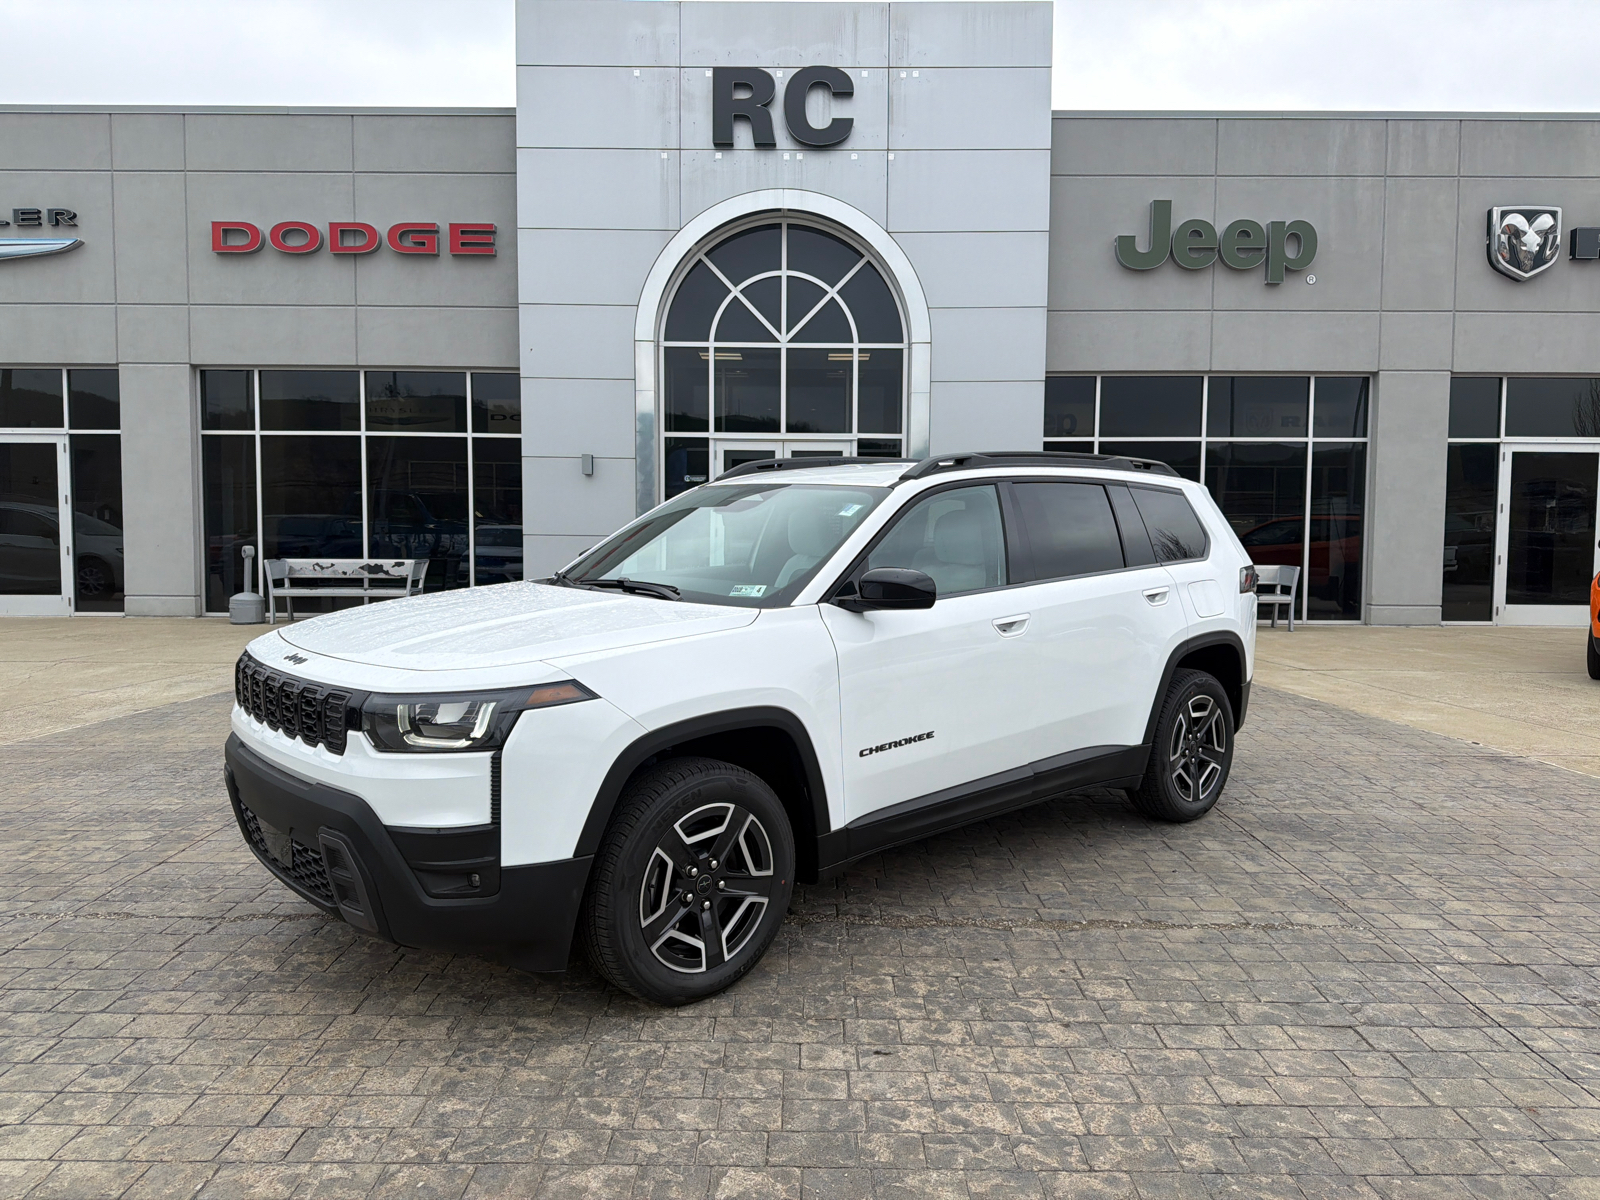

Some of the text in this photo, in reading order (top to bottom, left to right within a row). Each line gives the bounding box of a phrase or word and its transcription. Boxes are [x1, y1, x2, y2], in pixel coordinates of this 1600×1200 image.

[712, 65, 855, 149] RC
[211, 220, 497, 257] DODGE
[1114, 199, 1319, 286] Jeep
[858, 730, 935, 758] CHEROKEE
[652, 788, 702, 833] NEXEN
